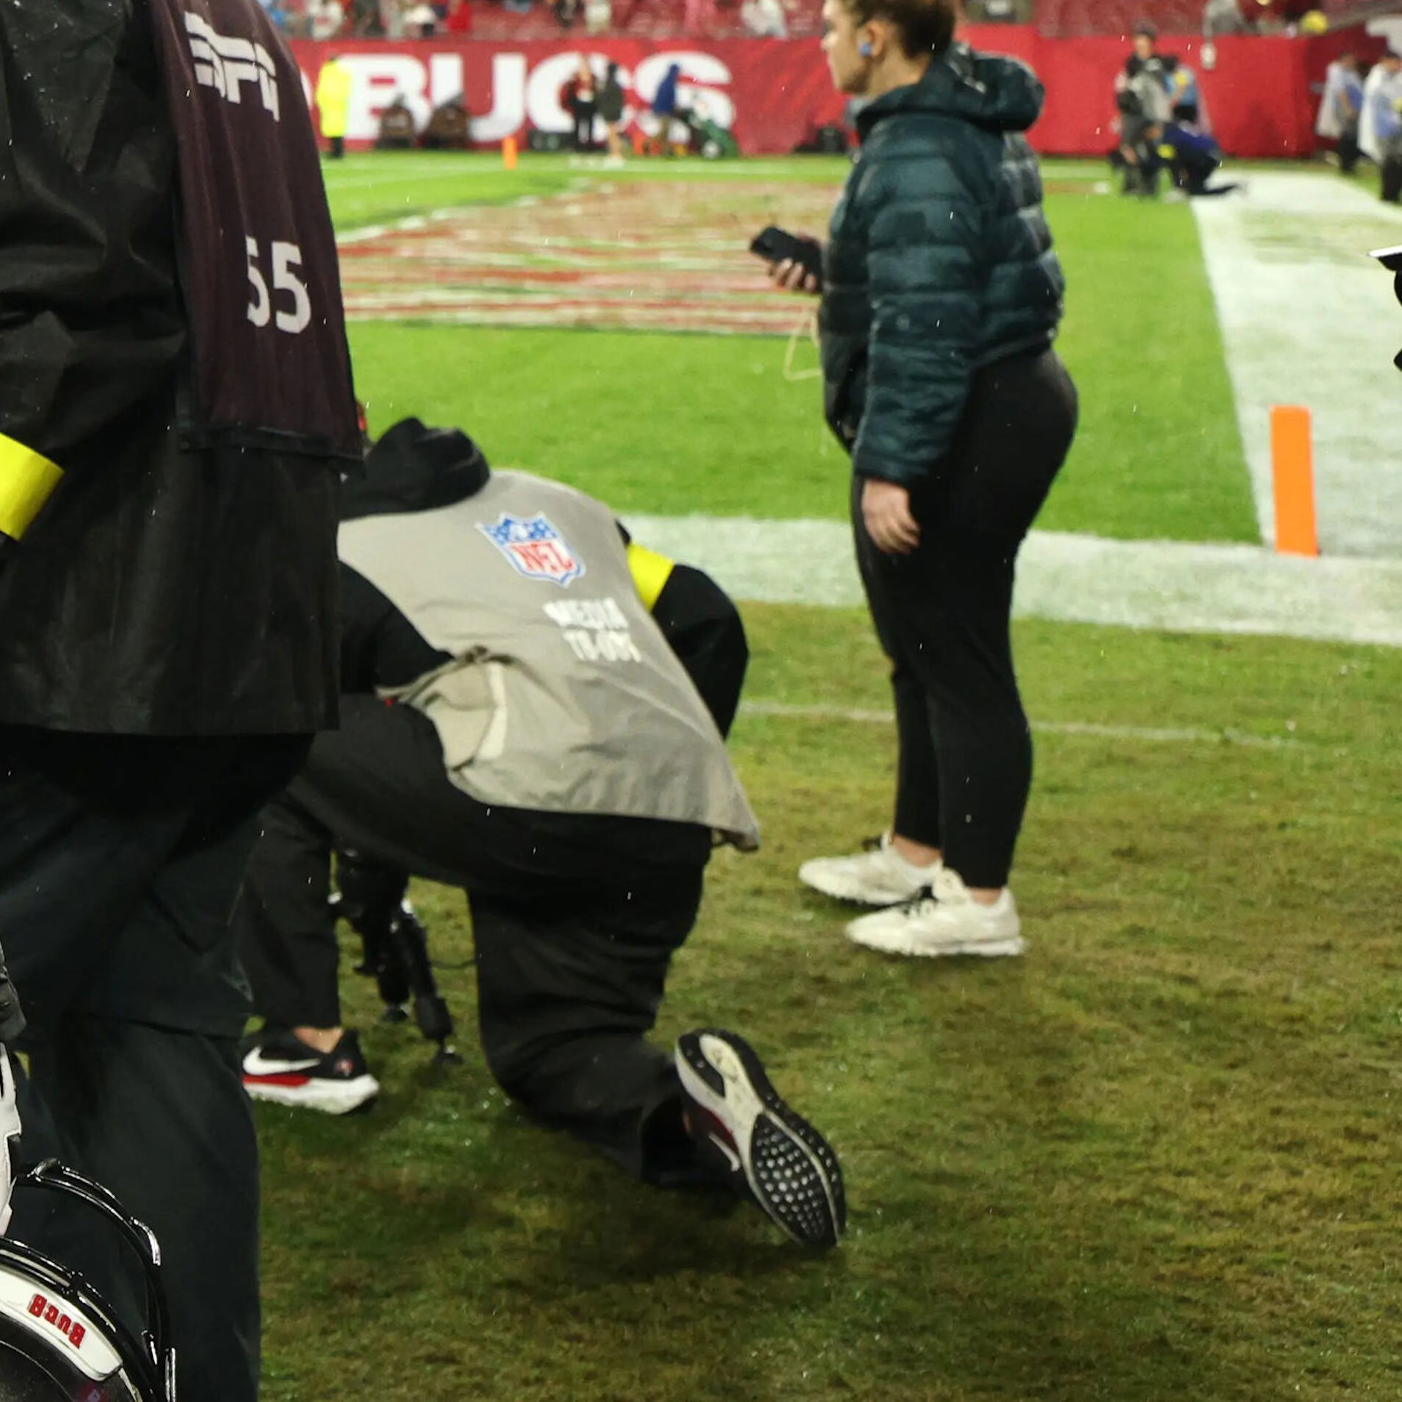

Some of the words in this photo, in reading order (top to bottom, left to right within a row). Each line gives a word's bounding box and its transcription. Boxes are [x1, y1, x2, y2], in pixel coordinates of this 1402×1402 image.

[339, 50, 737, 143] BUCS
[246, 235, 312, 335] 55
[509, 540, 576, 573] NFL
